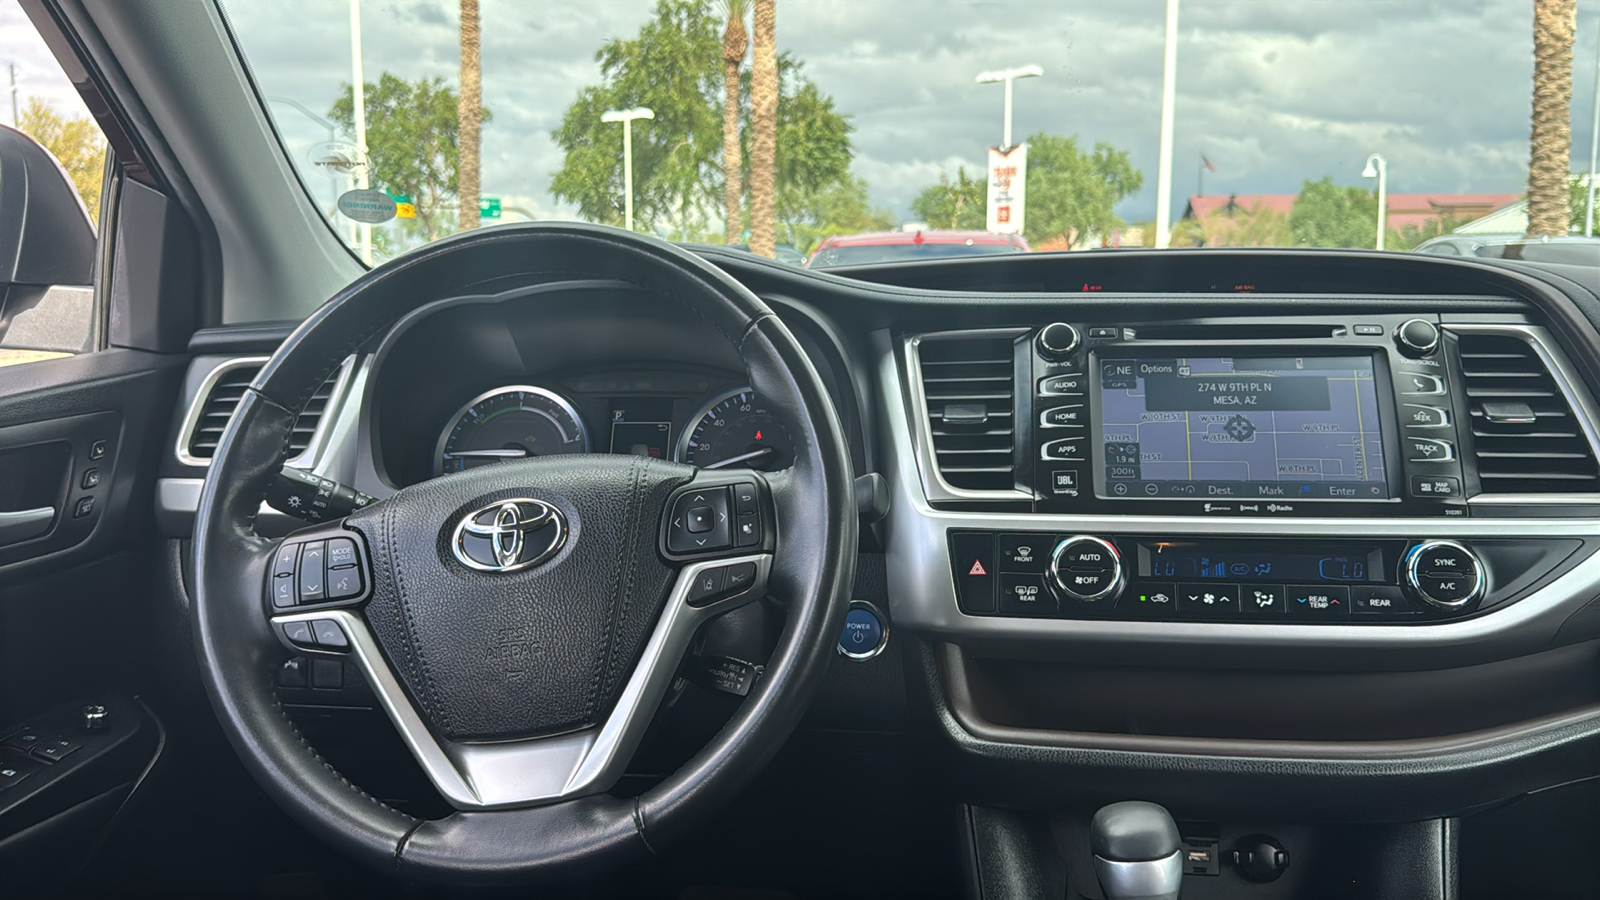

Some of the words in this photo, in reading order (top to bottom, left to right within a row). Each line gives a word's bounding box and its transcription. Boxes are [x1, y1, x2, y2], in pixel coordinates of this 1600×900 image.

[1116, 366, 1132, 375] NE
[1140, 364, 1173, 374] Options
[1054, 381, 1077, 389] AUDIO
[1198, 383, 1216, 392] 274
[1218, 383, 1227, 391] W
[1229, 383, 1249, 391] 9TH
[1250, 383, 1262, 391] PL
[1264, 383, 1272, 391] N
[1213, 396, 1242, 405] MESA,
[1244, 396, 1257, 404] AZ
[740, 404, 751, 412] 60
[713, 419, 725, 427] 40
[700, 443, 710, 451] 20
[1415, 444, 1438, 452] TRACK
[1116, 455, 1127, 463] 1.9
[1111, 467, 1135, 475] 300ft
[1057, 475, 1074, 485] JBL
[1208, 486, 1234, 495] Dest.
[1258, 486, 1284, 495] Mark
[1329, 487, 1355, 496] Enter
[313, 500, 327, 508] AUTO
[332, 547, 351, 555] MODE
[1434, 558, 1457, 566] SYNC
[1083, 576, 1099, 584] OFF
[1439, 582, 1456, 590] A/C
[1369, 599, 1391, 607] REAR
[846, 622, 871, 630] POWER
[499, 627, 527, 641] SRS
[484, 642, 541, 662] AIRBAG
[728, 663, 740, 673] RES
[722, 680, 735, 689] SET
